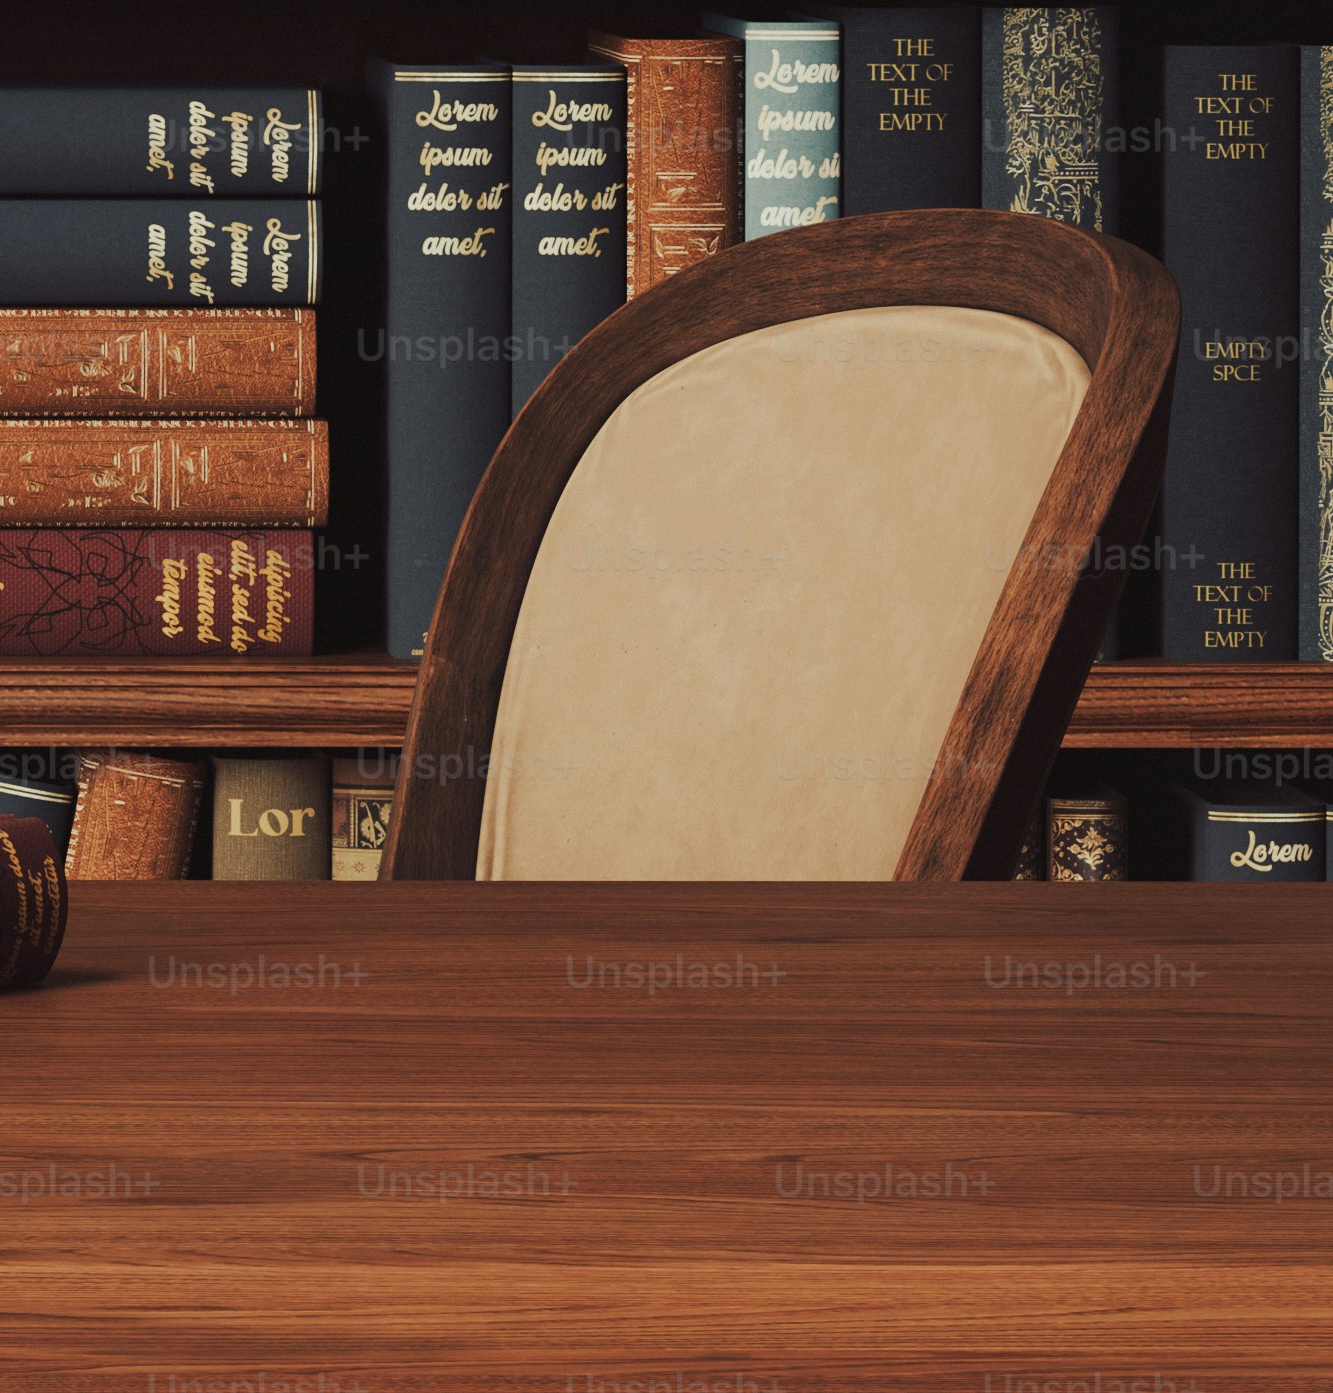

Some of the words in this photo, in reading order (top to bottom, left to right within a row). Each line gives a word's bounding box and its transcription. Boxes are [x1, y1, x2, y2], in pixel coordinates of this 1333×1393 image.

[1219, 74, 1256, 91] THE
[415, 90, 498, 131] Lorem
[1195, 97, 1243, 113] TEXT
[1249, 97, 1273, 114] OF
[1215, 120, 1254, 136] THE
[420, 142, 492, 174] ipsum
[1206, 143, 1266, 159] EMPTY
[408, 183, 472, 211] dolor
[476, 183, 511, 210] sit
[422, 228, 494, 257] amet,
[223, 798, 314, 843] Lor
[1230, 830, 1312, 872] Lorem
